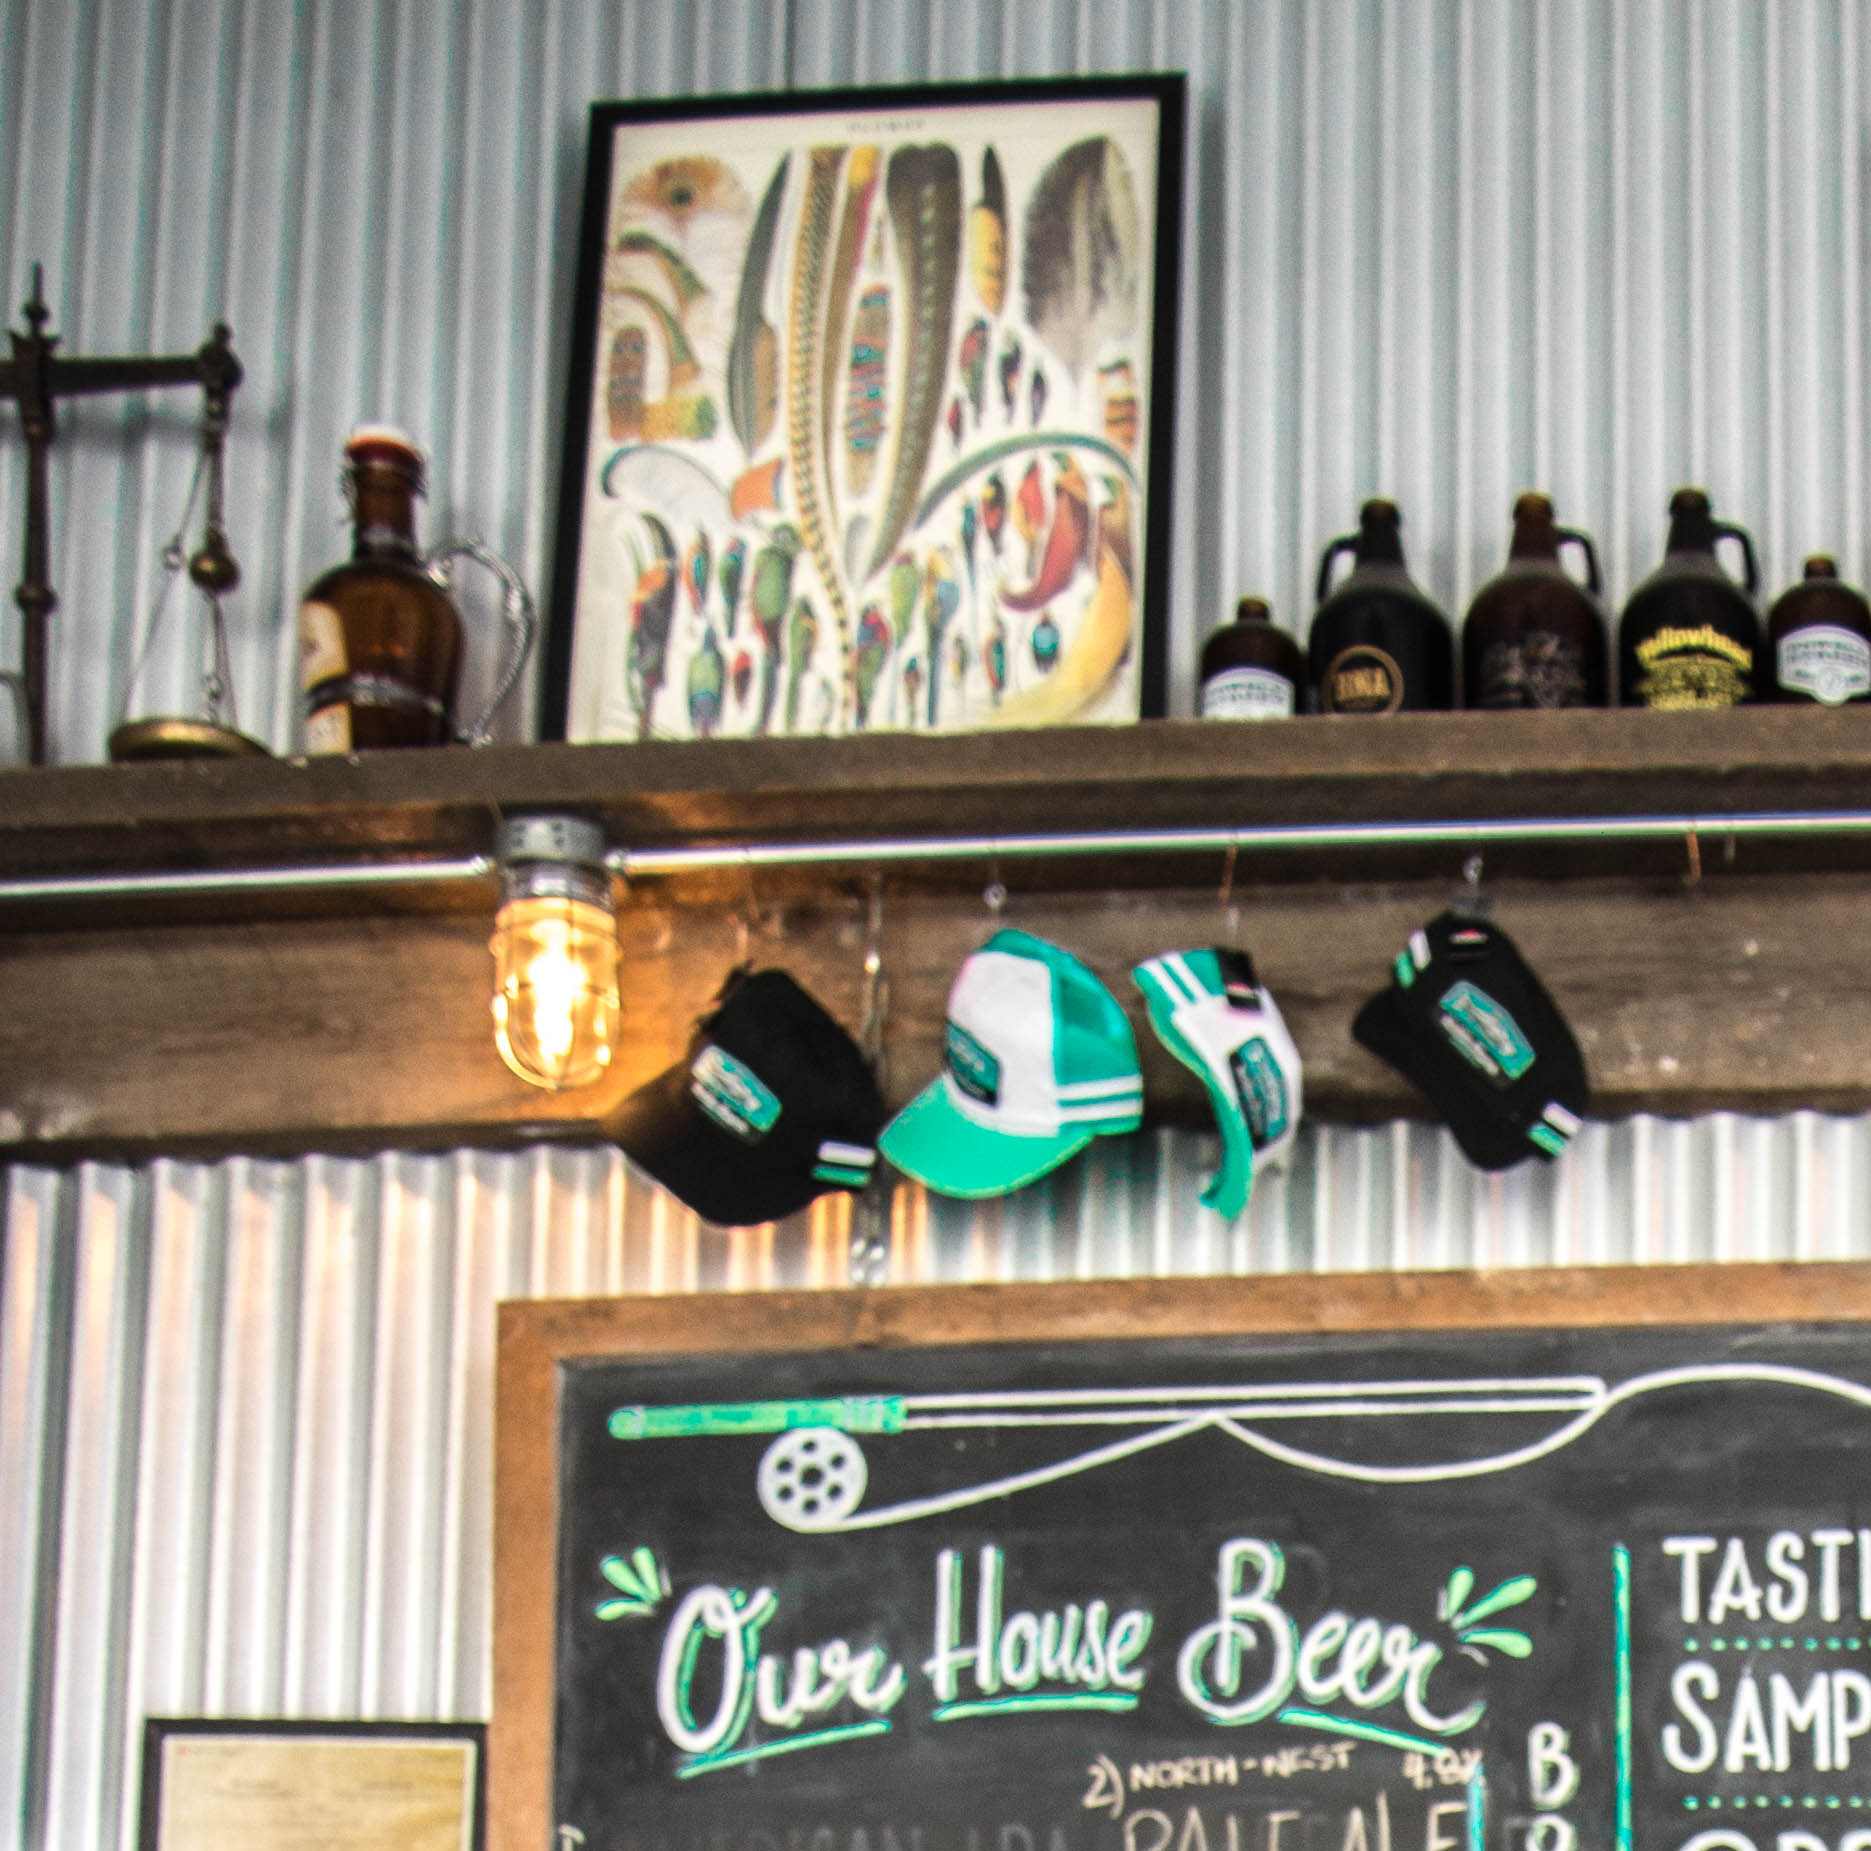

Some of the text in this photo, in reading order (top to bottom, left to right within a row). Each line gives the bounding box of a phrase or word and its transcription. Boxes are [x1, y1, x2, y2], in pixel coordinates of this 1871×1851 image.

[655, 1537, 1488, 1754] Our House Beer
